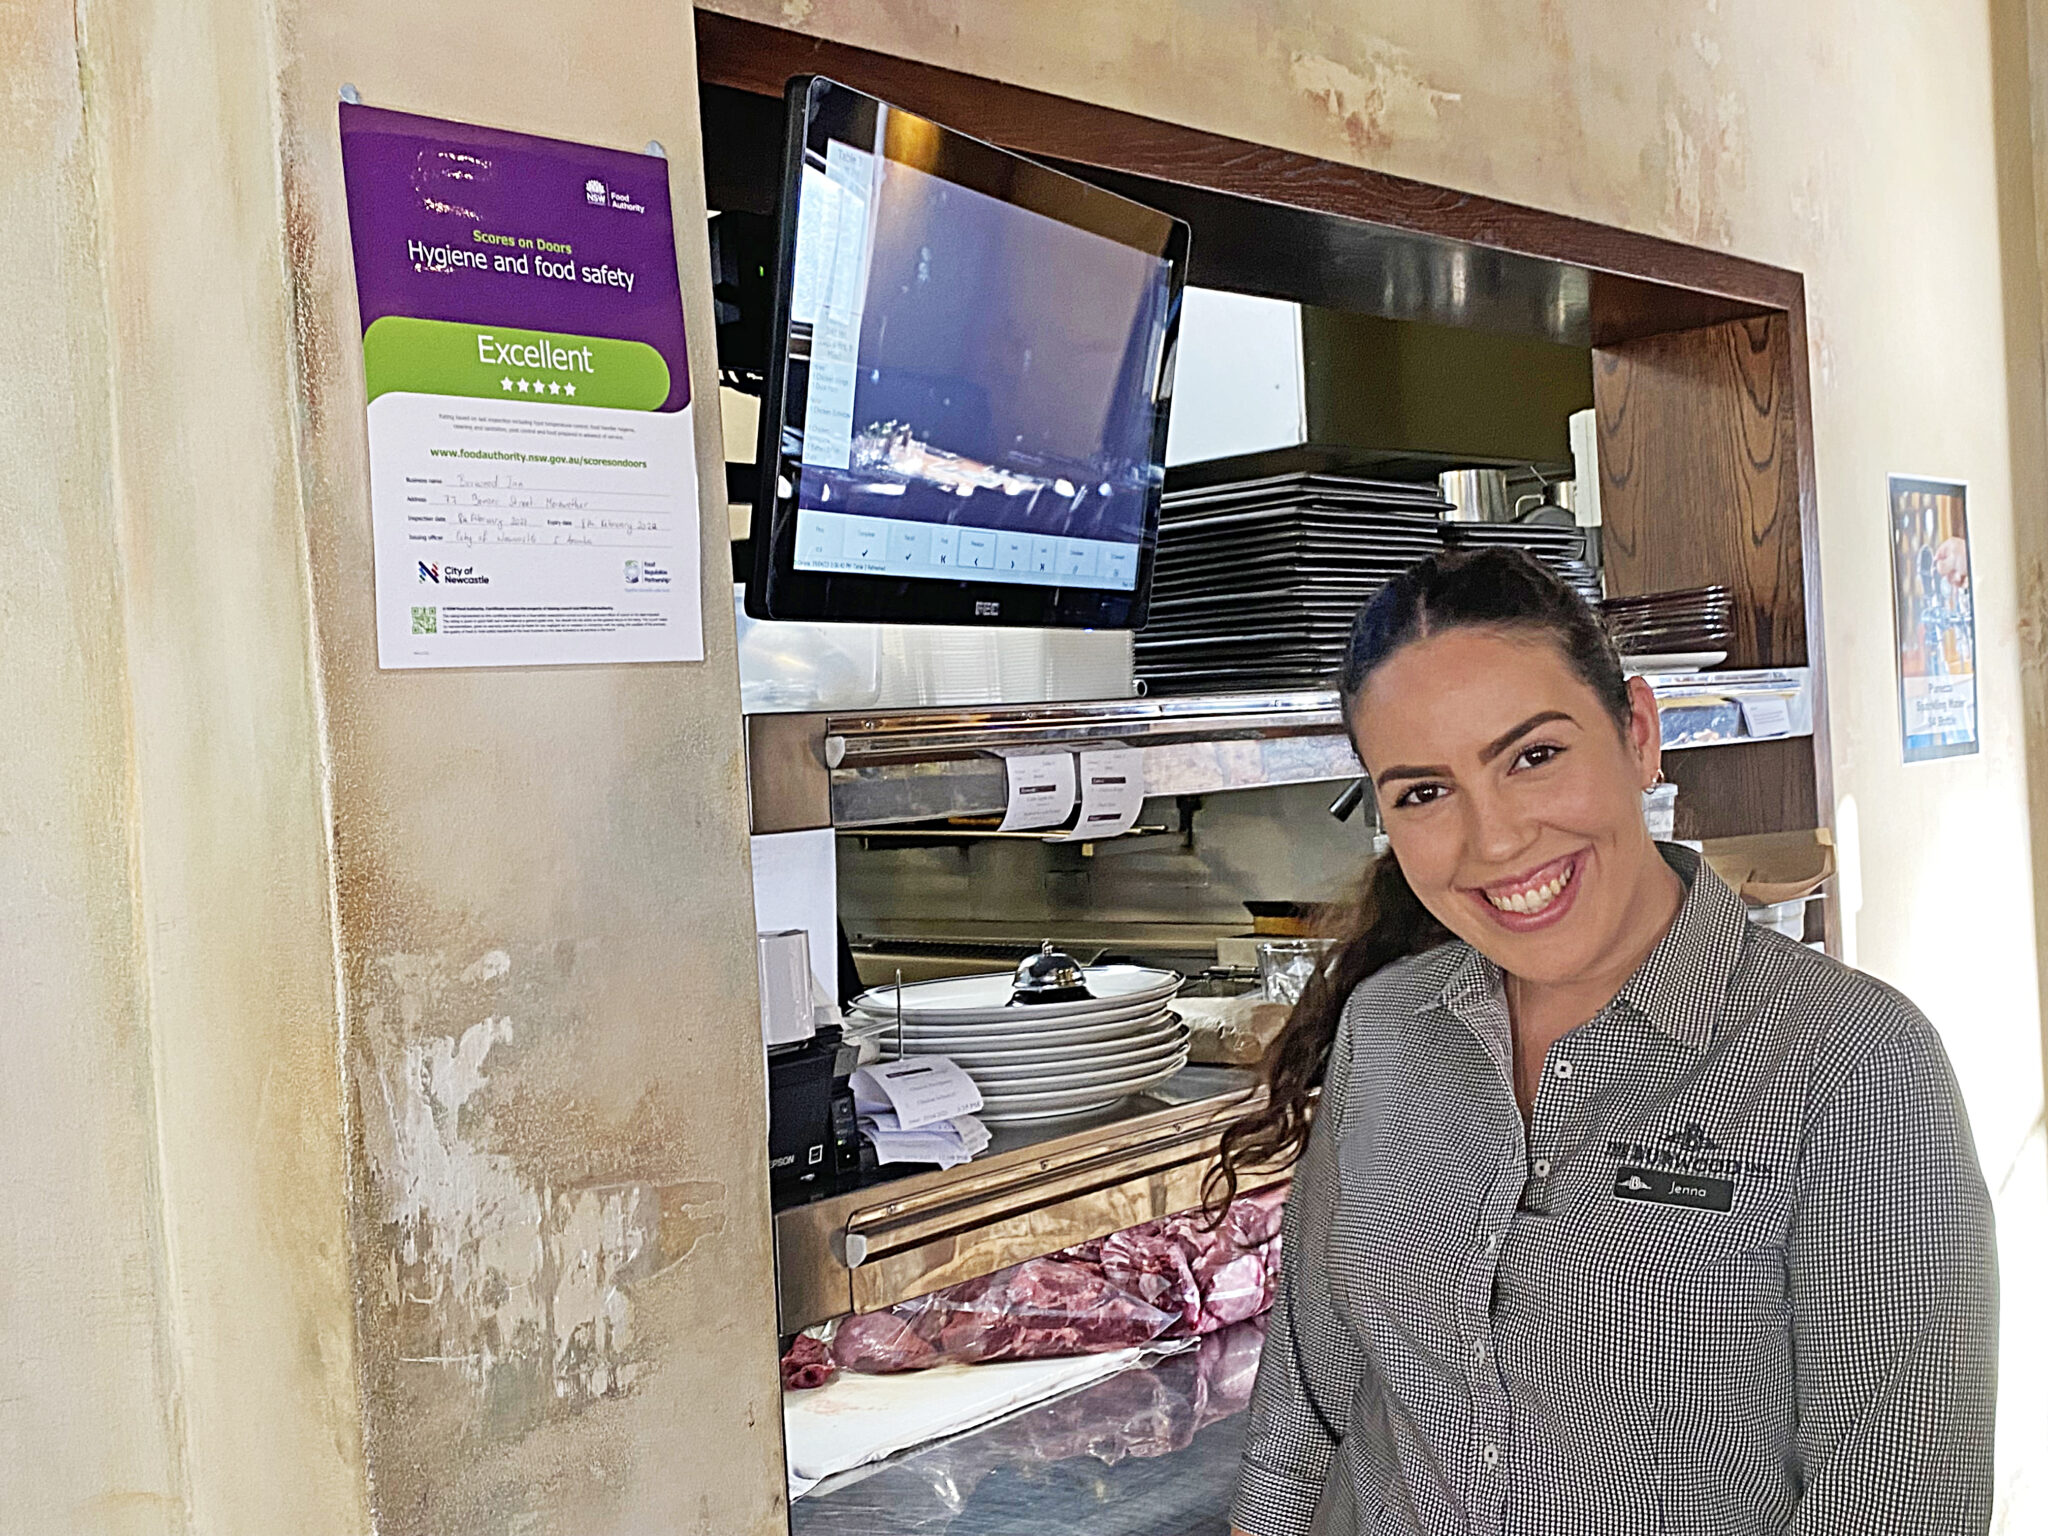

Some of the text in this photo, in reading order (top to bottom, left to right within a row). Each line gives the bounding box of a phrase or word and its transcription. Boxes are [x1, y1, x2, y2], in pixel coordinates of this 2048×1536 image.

[586, 193, 606, 204] NSW
[610, 192, 629, 202] Food
[612, 201, 645, 214] Authority
[472, 229, 572, 255] Scores on Doors
[407, 239, 635, 293] Hygiene and food safety
[477, 334, 595, 374] Excellent
[430, 448, 647, 470] www.foodauthority.nsw.gov.au/scoresondoors
[444, 565, 474, 577] City of
[444, 575, 490, 585] Newcastle
[1667, 1180, 1707, 1197] Jenna
